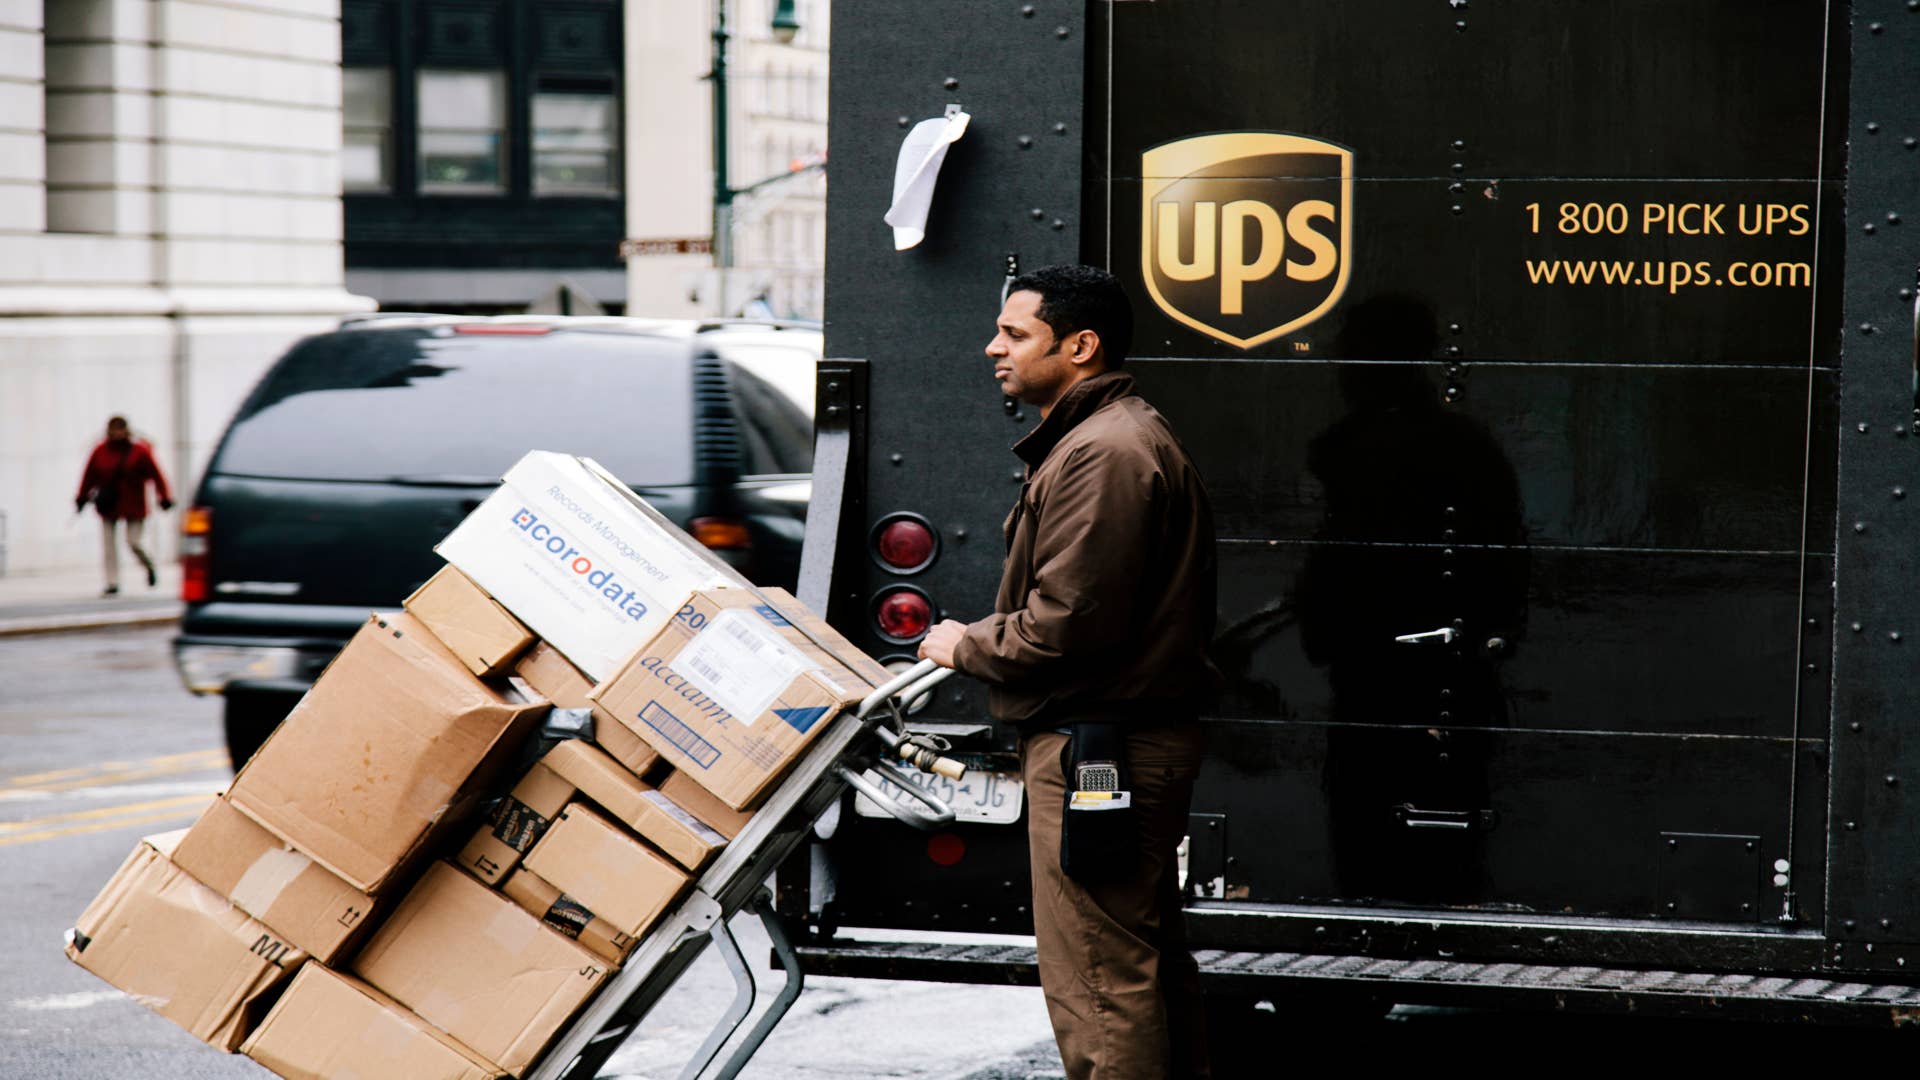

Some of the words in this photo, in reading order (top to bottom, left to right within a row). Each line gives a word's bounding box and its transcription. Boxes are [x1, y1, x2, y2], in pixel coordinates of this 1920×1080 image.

[1525, 202, 1541, 234] 1
[1557, 202, 1629, 234] 800
[1642, 203, 1726, 235] PICK
[1738, 203, 1810, 236] UPS
[1157, 199, 1338, 315] ups
[1525, 260, 1812, 294] www.ups.com
[1293, 342, 1310, 351] TM
[547, 485, 595, 525] Records
[591, 520, 670, 583] Management
[531, 523, 648, 621] corodata
[677, 604, 708, 632] 20
[249, 933, 290, 969] ML
[579, 965, 600, 981] JT
